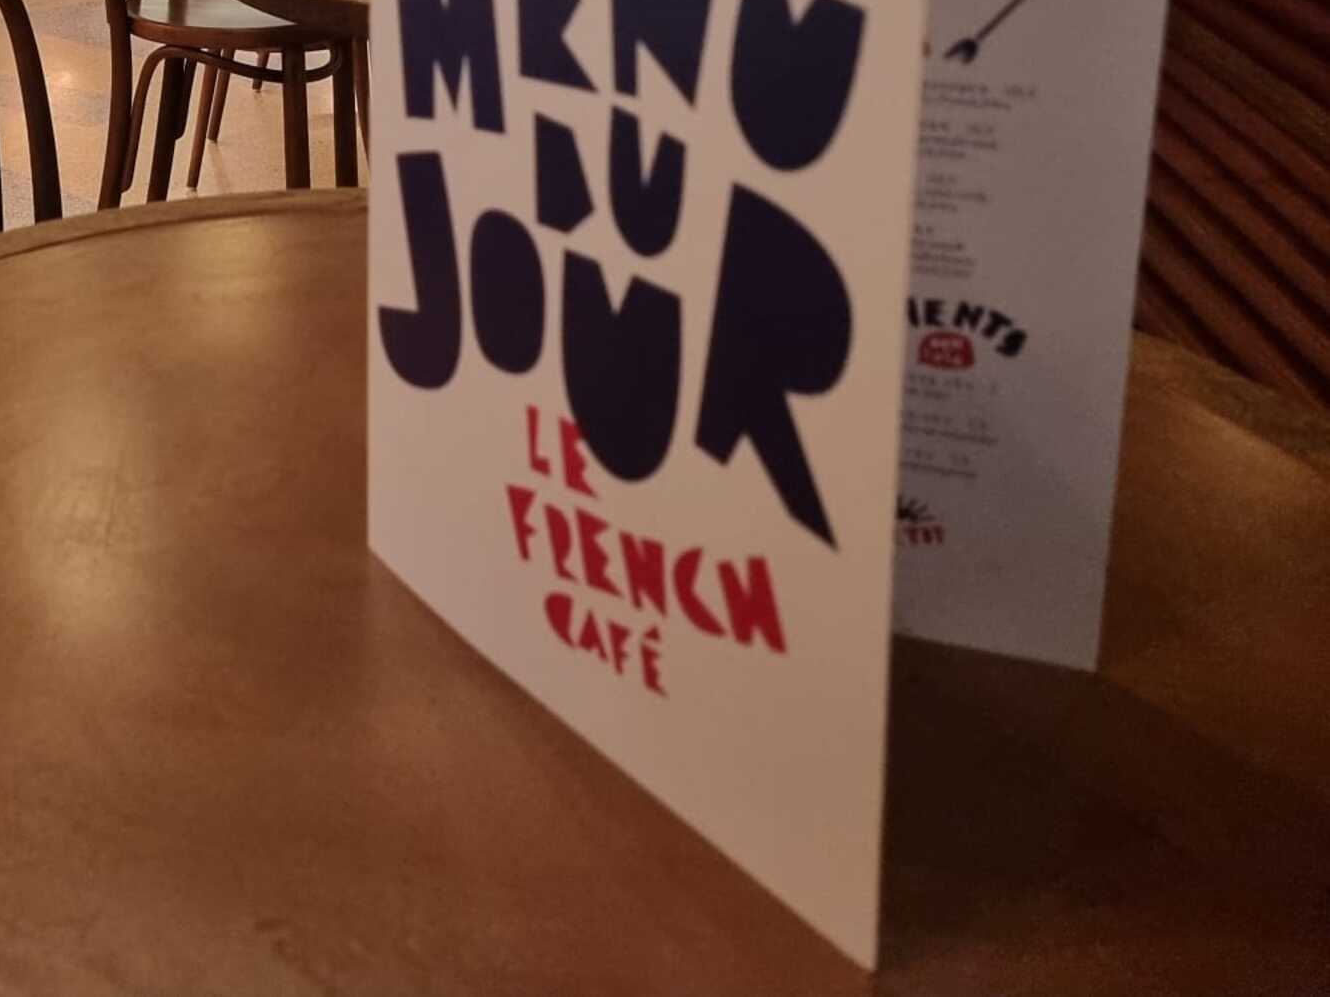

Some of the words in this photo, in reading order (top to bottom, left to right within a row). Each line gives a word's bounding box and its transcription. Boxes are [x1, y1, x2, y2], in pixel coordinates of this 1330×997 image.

[533, 105, 687, 259] DU
[377, 150, 854, 552] JOUR
[526, 404, 599, 500] LE
[506, 484, 787, 655] FRENCH
[544, 591, 668, 697] CAFÉ
